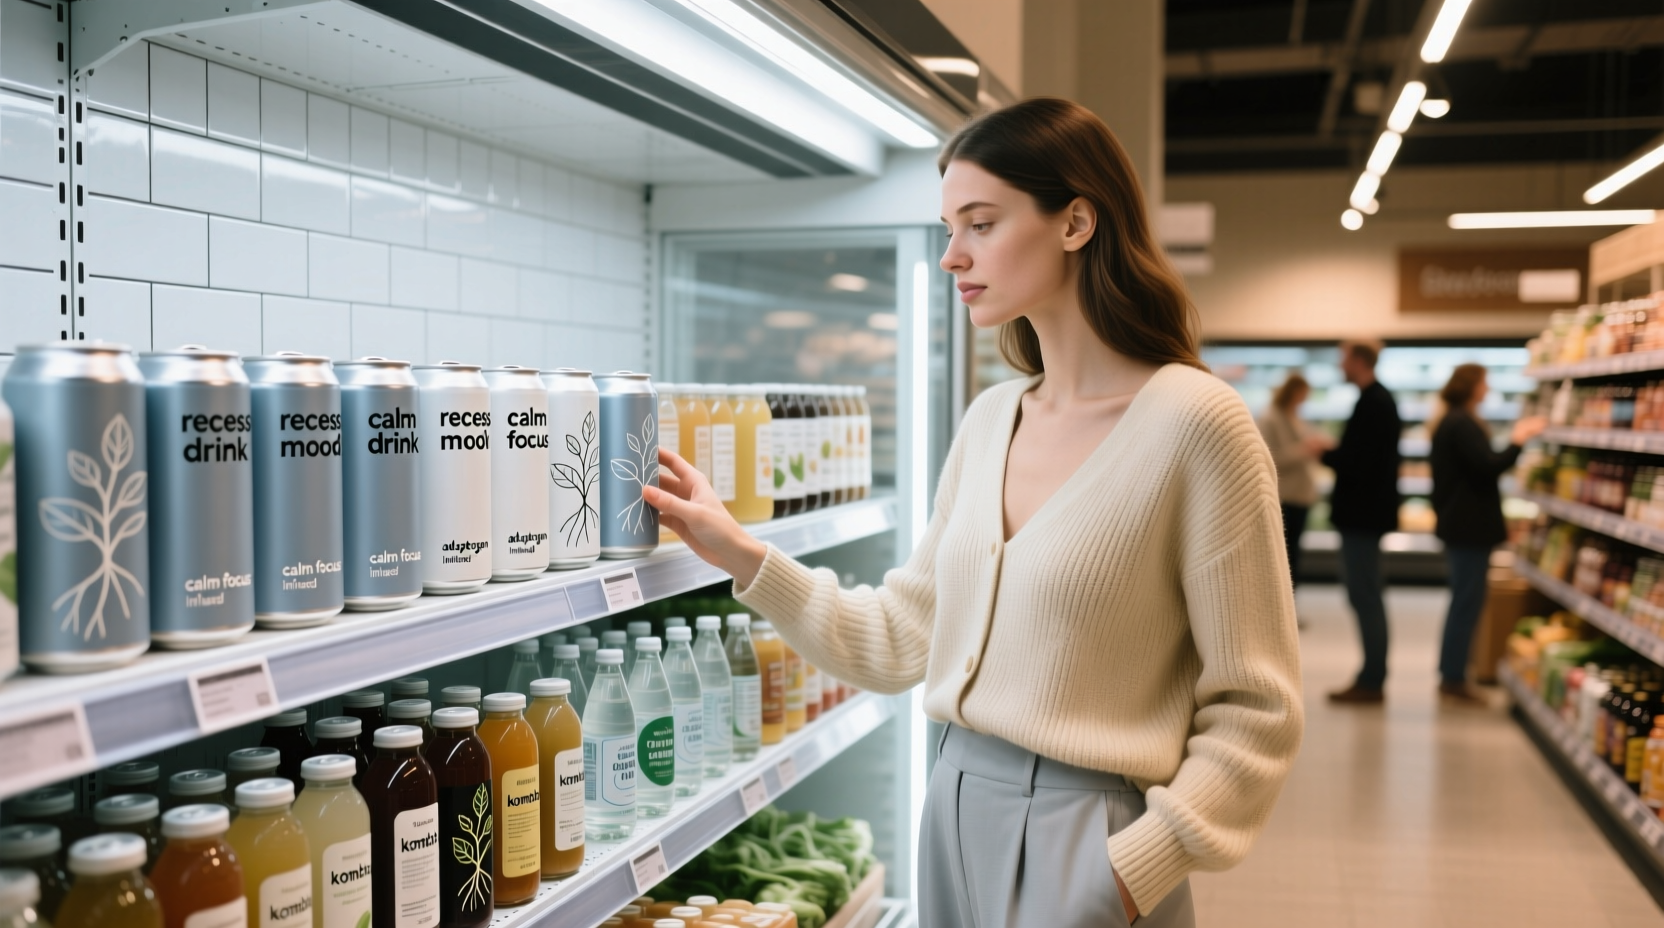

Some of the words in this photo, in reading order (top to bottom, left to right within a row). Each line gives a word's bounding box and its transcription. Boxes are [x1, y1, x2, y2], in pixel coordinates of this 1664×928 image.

[181, 413, 251, 433] recess
[280, 412, 341, 431] recess
[368, 406, 417, 429] calm
[441, 411, 491, 427] recess
[507, 406, 547, 427] calm
[280, 433, 341, 458] mood
[367, 431, 419, 455] drink
[506, 429, 549, 449] focus
[183, 436, 248, 463] drink
[369, 549, 398, 564] calm
[282, 561, 314, 577] calm
[185, 574, 221, 592] calm
